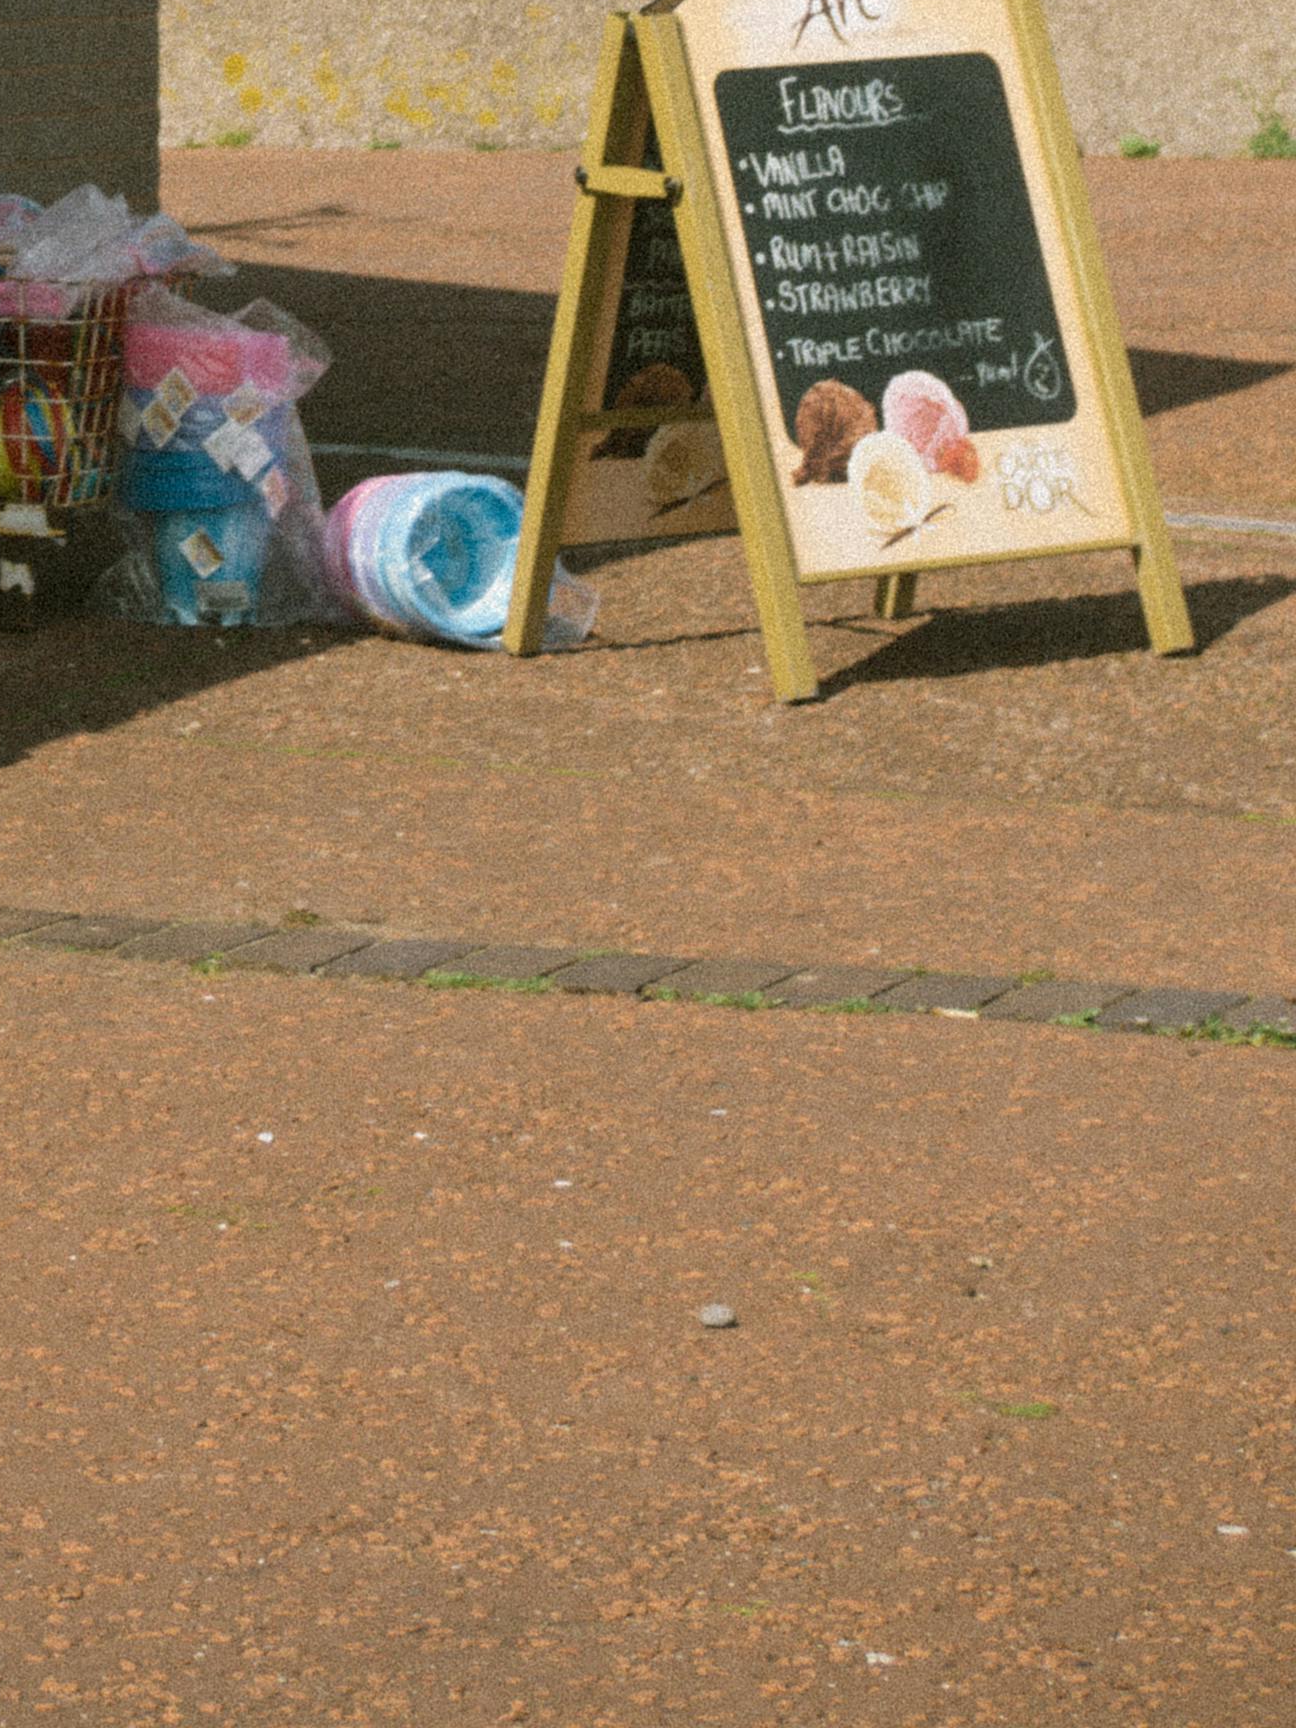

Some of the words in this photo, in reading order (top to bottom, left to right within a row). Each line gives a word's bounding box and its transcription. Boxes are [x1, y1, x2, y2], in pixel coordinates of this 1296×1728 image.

[777, 76, 907, 125] FLAVOURS
[749, 144, 848, 188] VANILLA
[762, 188, 818, 221] MINT
[827, 184, 892, 217] CHOC
[777, 273, 932, 316] STRAWBERRY
[785, 335, 865, 366] TRIPLE
[865, 316, 1006, 367] CHOCOLATE
